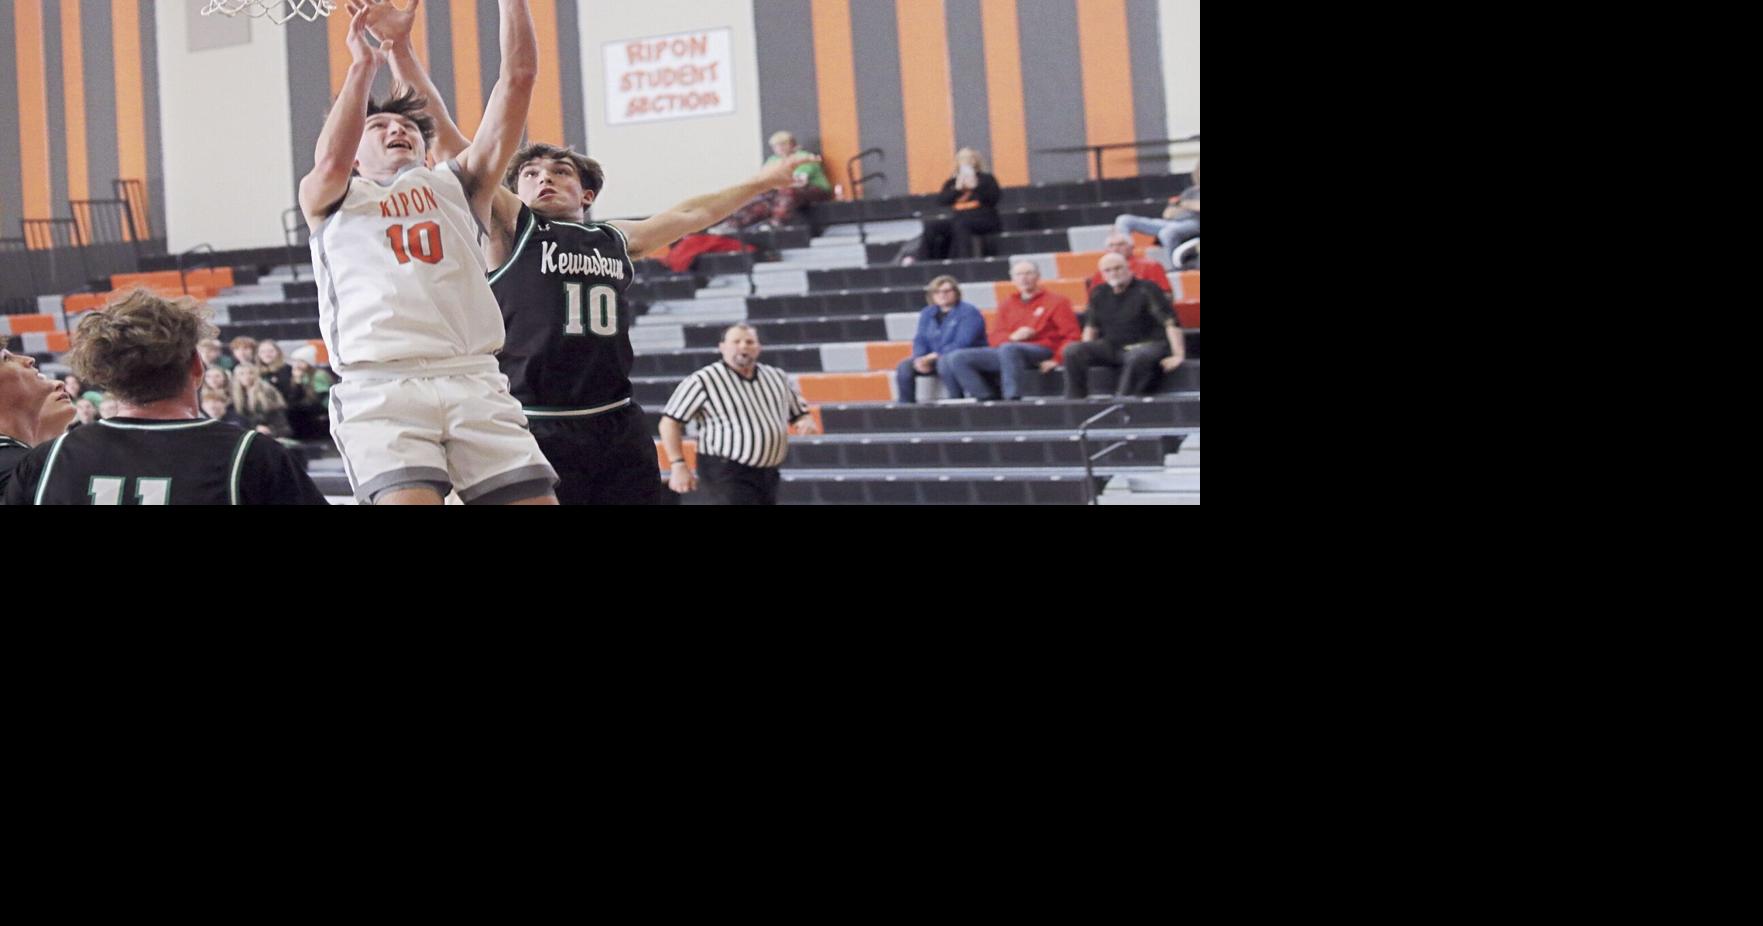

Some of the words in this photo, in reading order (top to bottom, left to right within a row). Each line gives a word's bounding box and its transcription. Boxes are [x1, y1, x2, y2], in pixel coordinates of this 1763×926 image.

[625, 34, 707, 64] RIPON
[620, 61, 719, 91] STUDENT
[625, 92, 720, 117] SECTION
[386, 221, 444, 265] 10
[563, 282, 617, 336] 10
